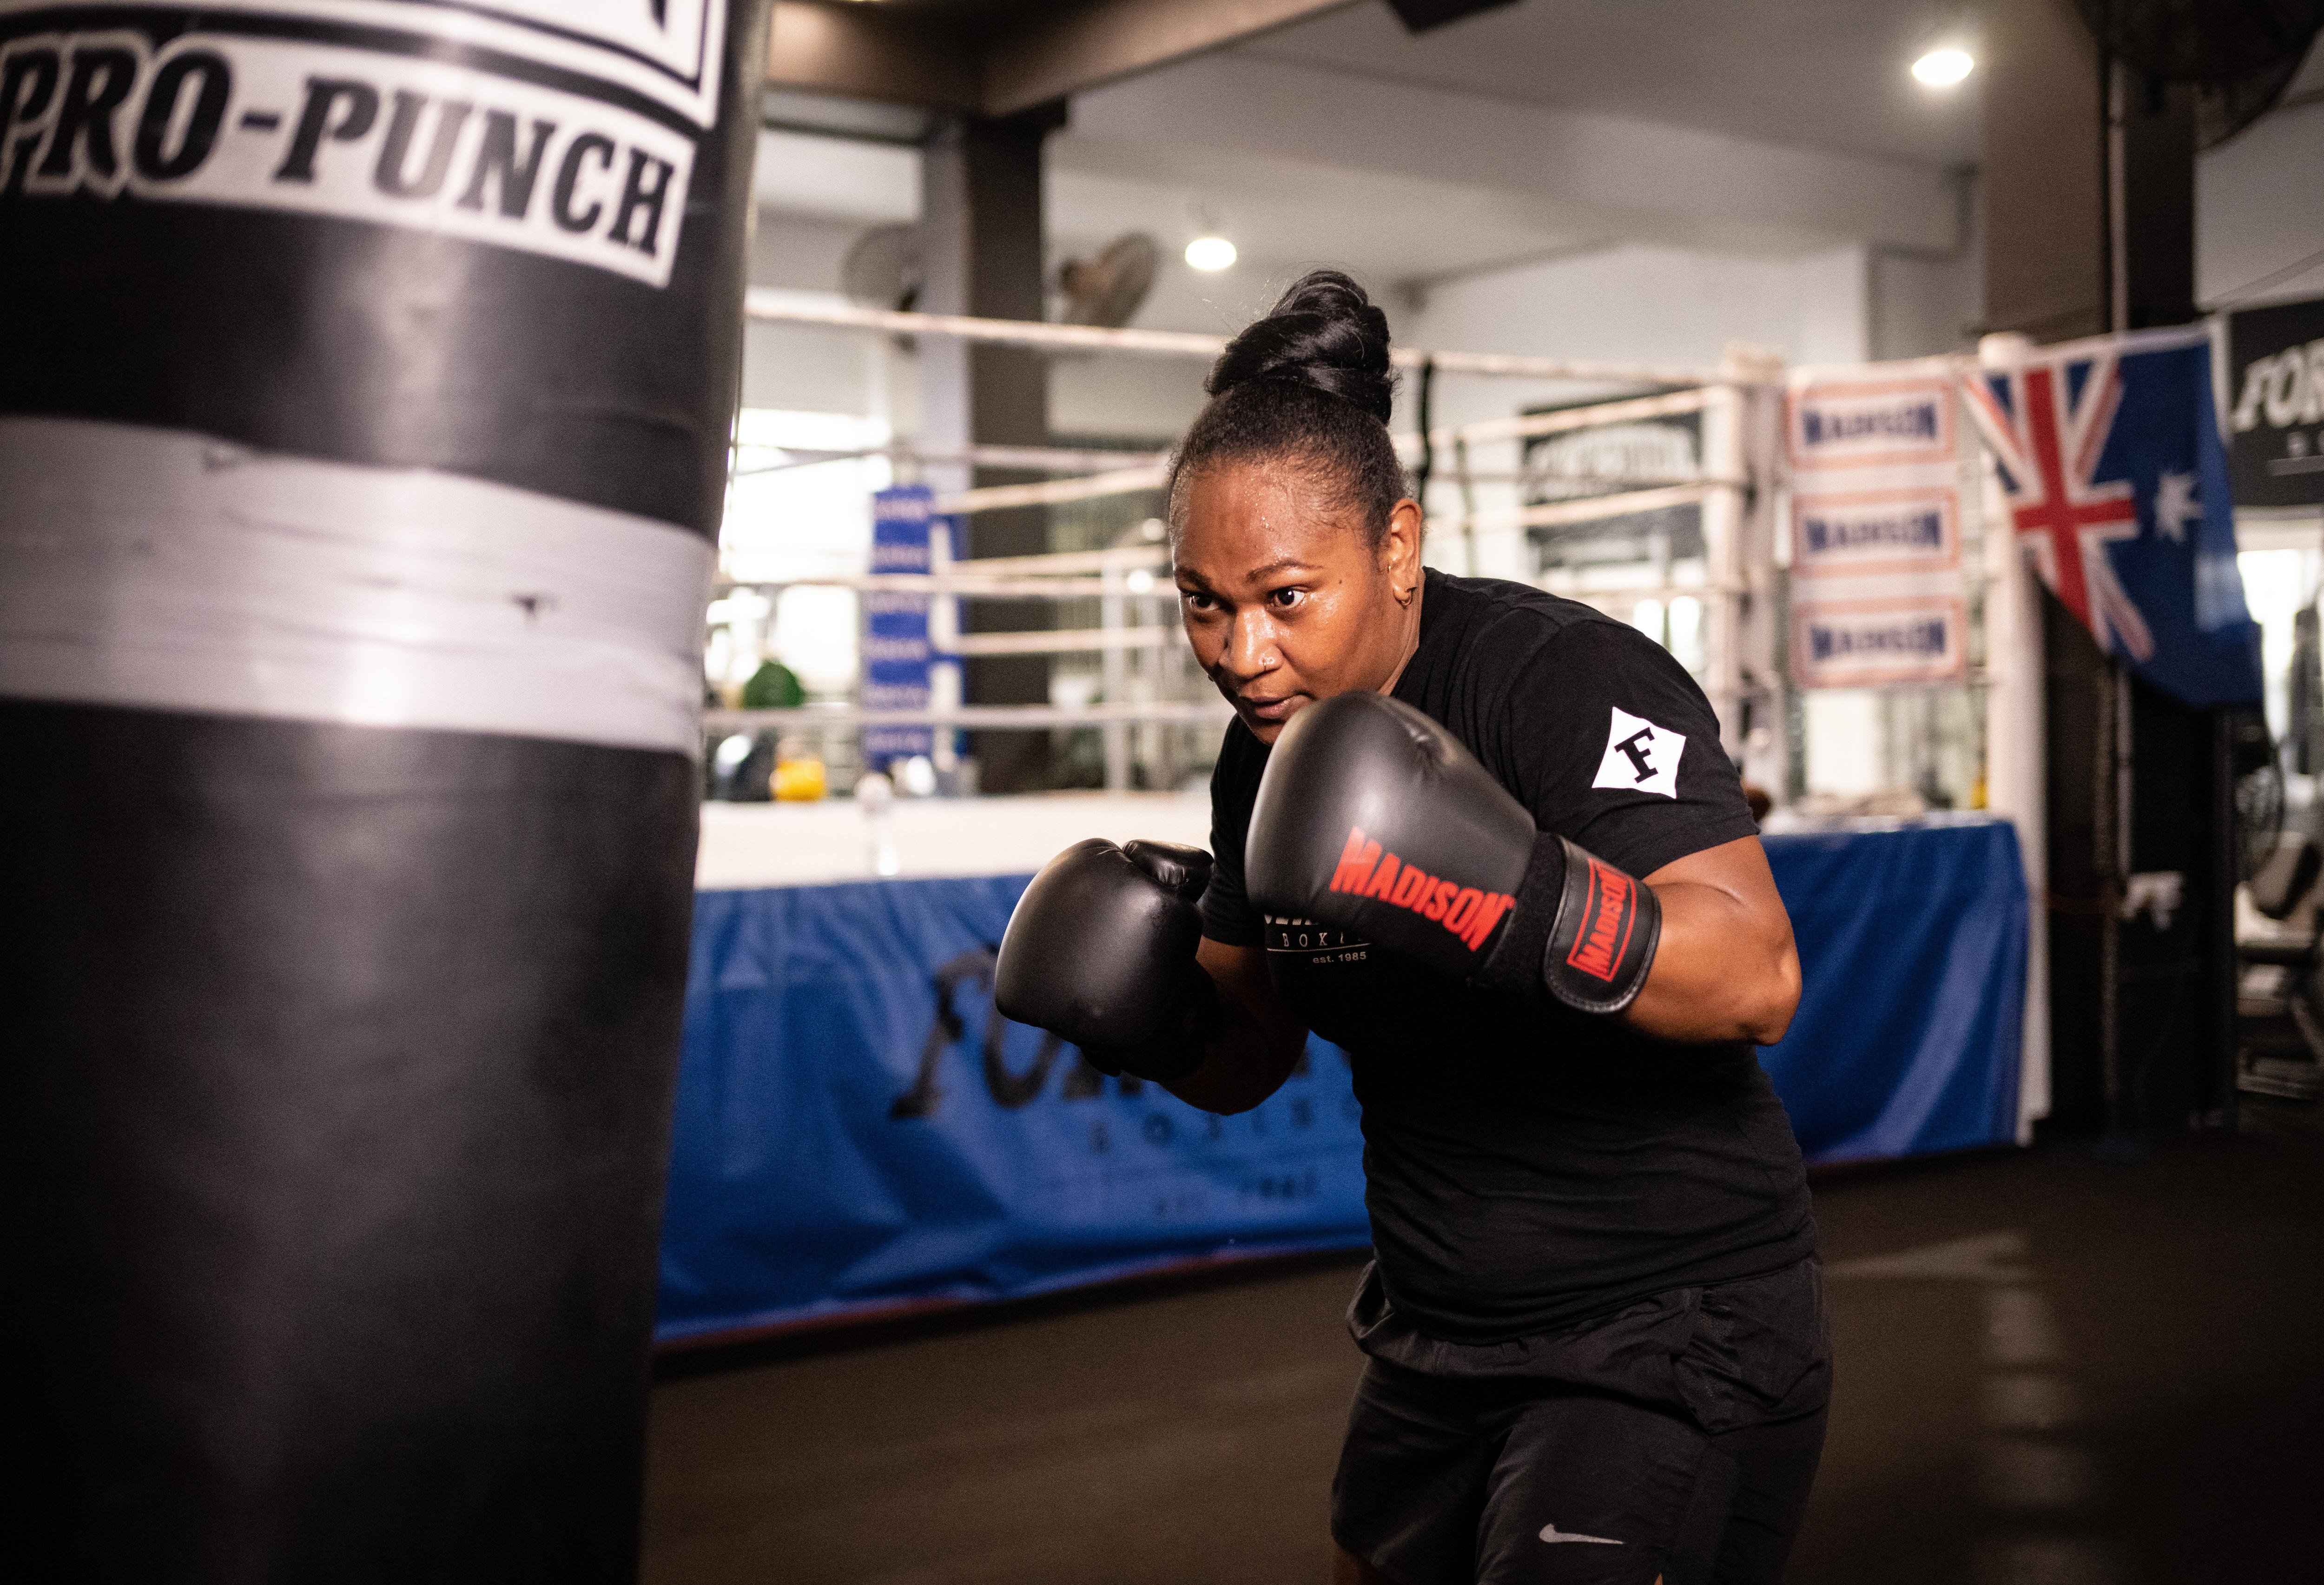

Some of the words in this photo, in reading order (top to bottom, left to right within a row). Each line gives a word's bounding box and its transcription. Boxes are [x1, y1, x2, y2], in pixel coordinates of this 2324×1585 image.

[0, 48, 675, 258] PRO-PUNCH
[1614, 726, 1658, 784] F
[1329, 826, 1512, 952] MADISON
[1575, 865, 1628, 975] MADISON
[1282, 930, 1362, 947] BOXI
[1313, 955, 1334, 964] est.
[1338, 951, 1367, 962] 1985
